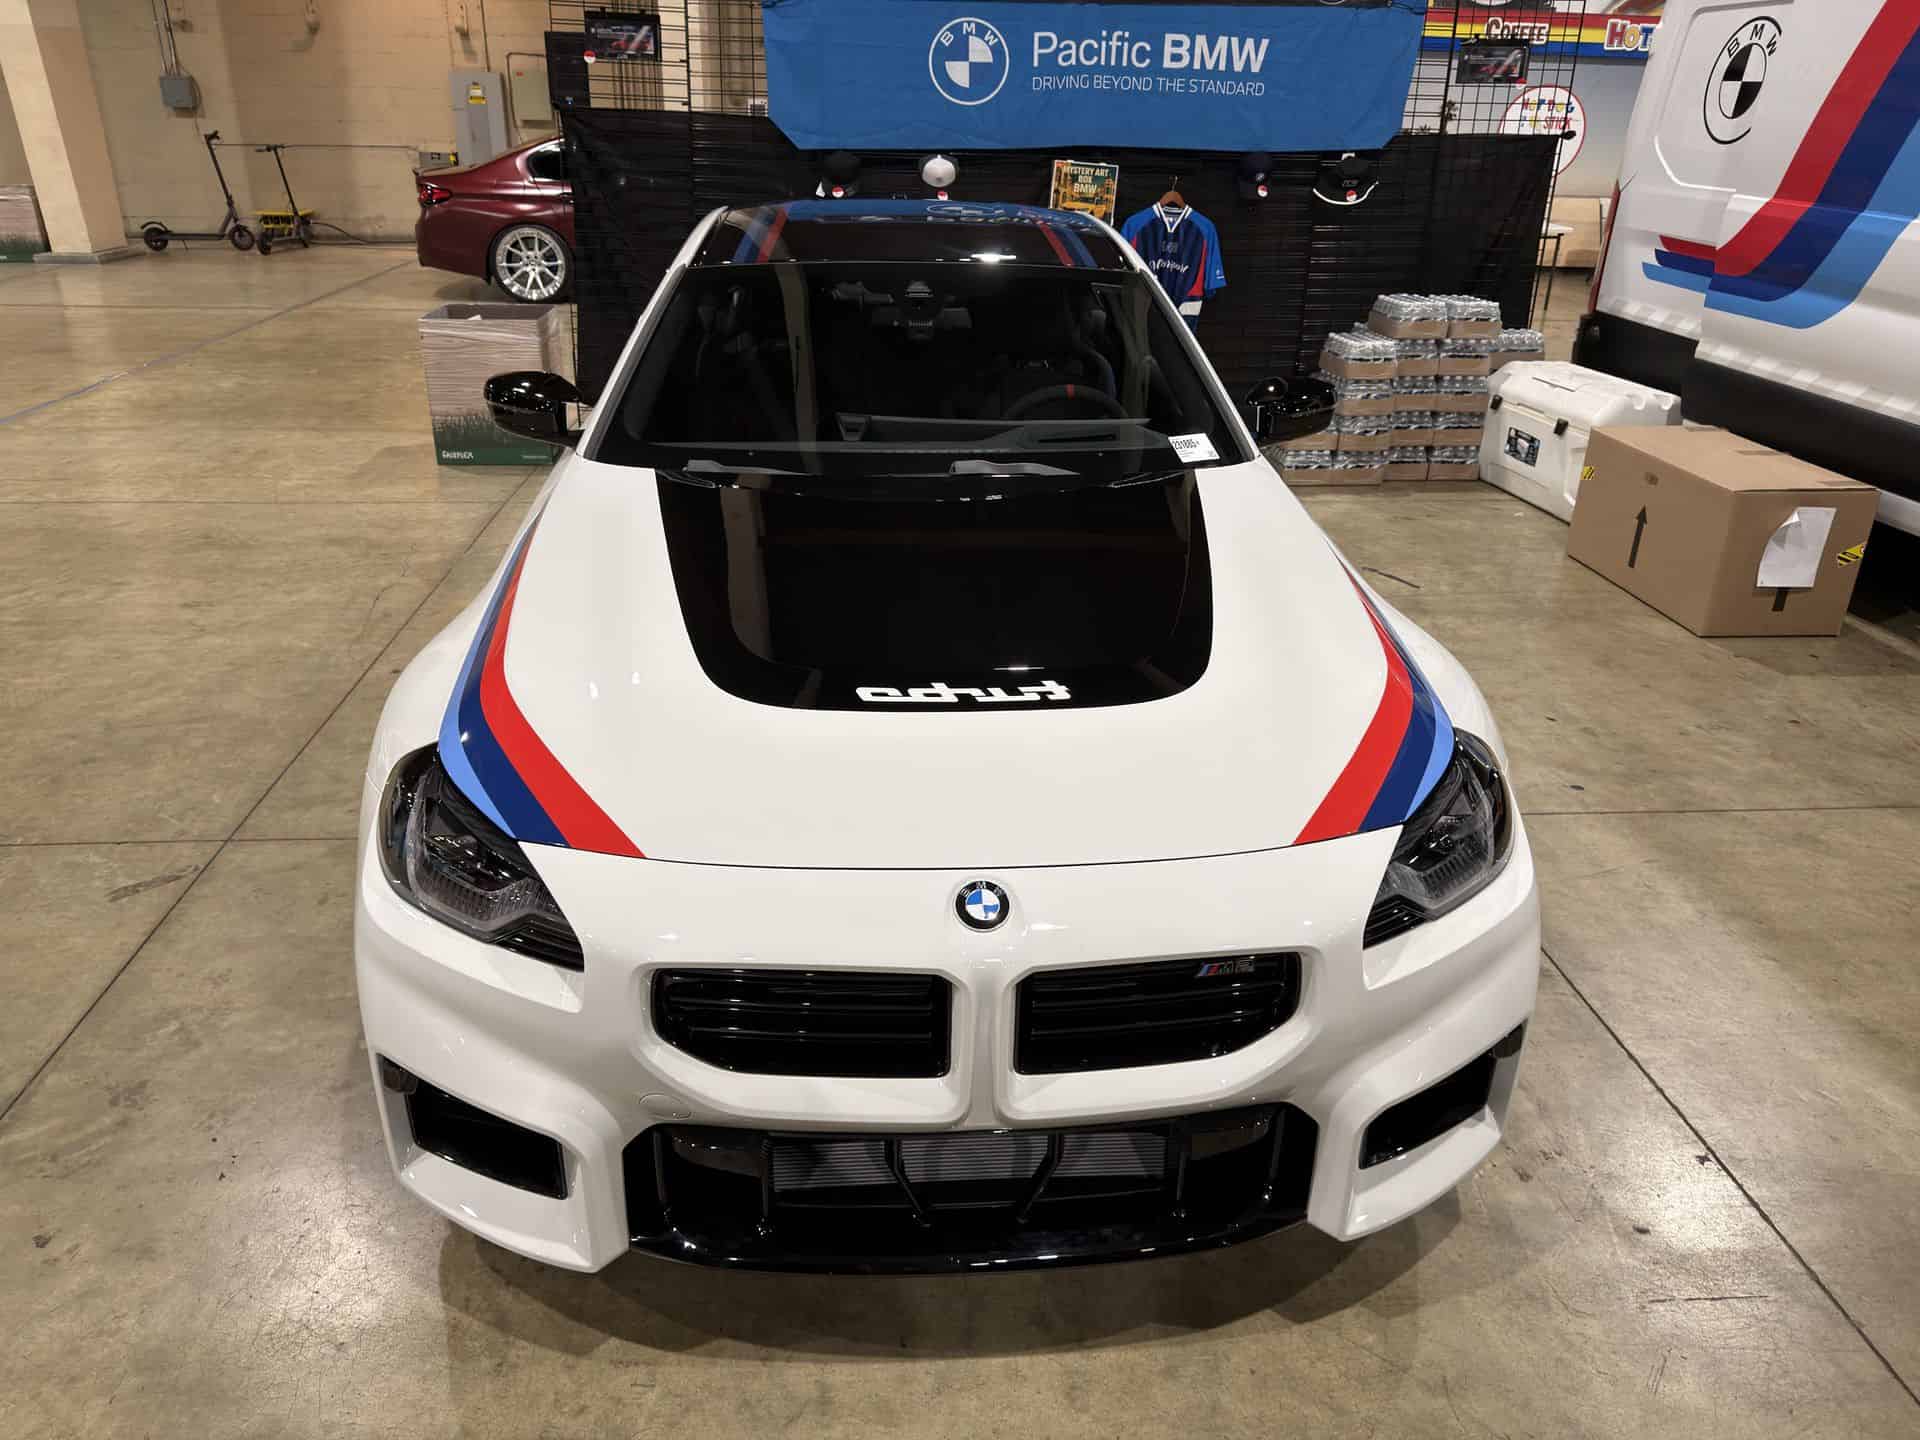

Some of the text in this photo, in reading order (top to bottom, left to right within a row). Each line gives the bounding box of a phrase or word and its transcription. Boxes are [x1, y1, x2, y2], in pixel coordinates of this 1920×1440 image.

[940, 22, 999, 47] BMW
[1727, 23, 1777, 57] BMW
[1032, 30, 1270, 73] Pacific BMW
[1032, 75, 1265, 97] DRIVING BEYOND THE STANDARD
[1073, 183, 1098, 193] BMW
